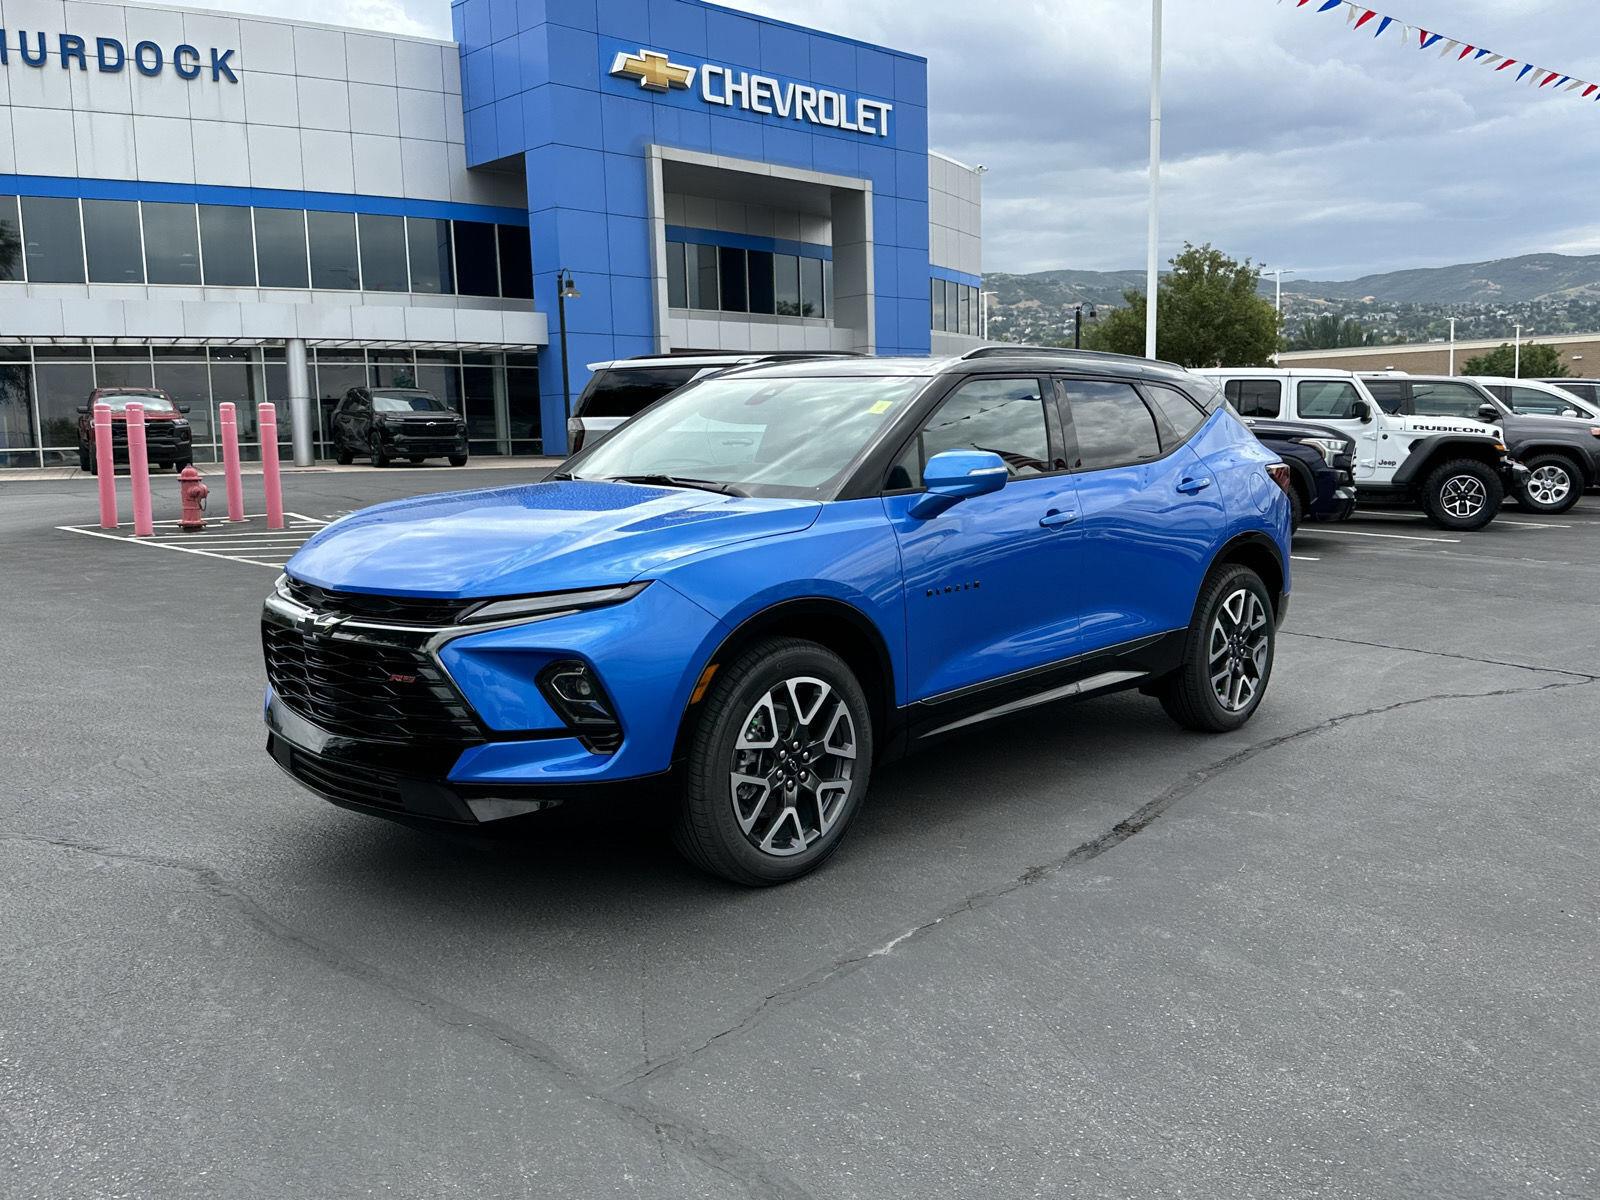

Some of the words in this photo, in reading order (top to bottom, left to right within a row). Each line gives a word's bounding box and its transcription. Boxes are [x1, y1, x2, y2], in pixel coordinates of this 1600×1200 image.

[0, 28, 238, 84] URDOCK
[701, 63, 893, 137] CHEVROLET
[1412, 424, 1486, 434] RUBICON
[1378, 459, 1397, 467] Jeep
